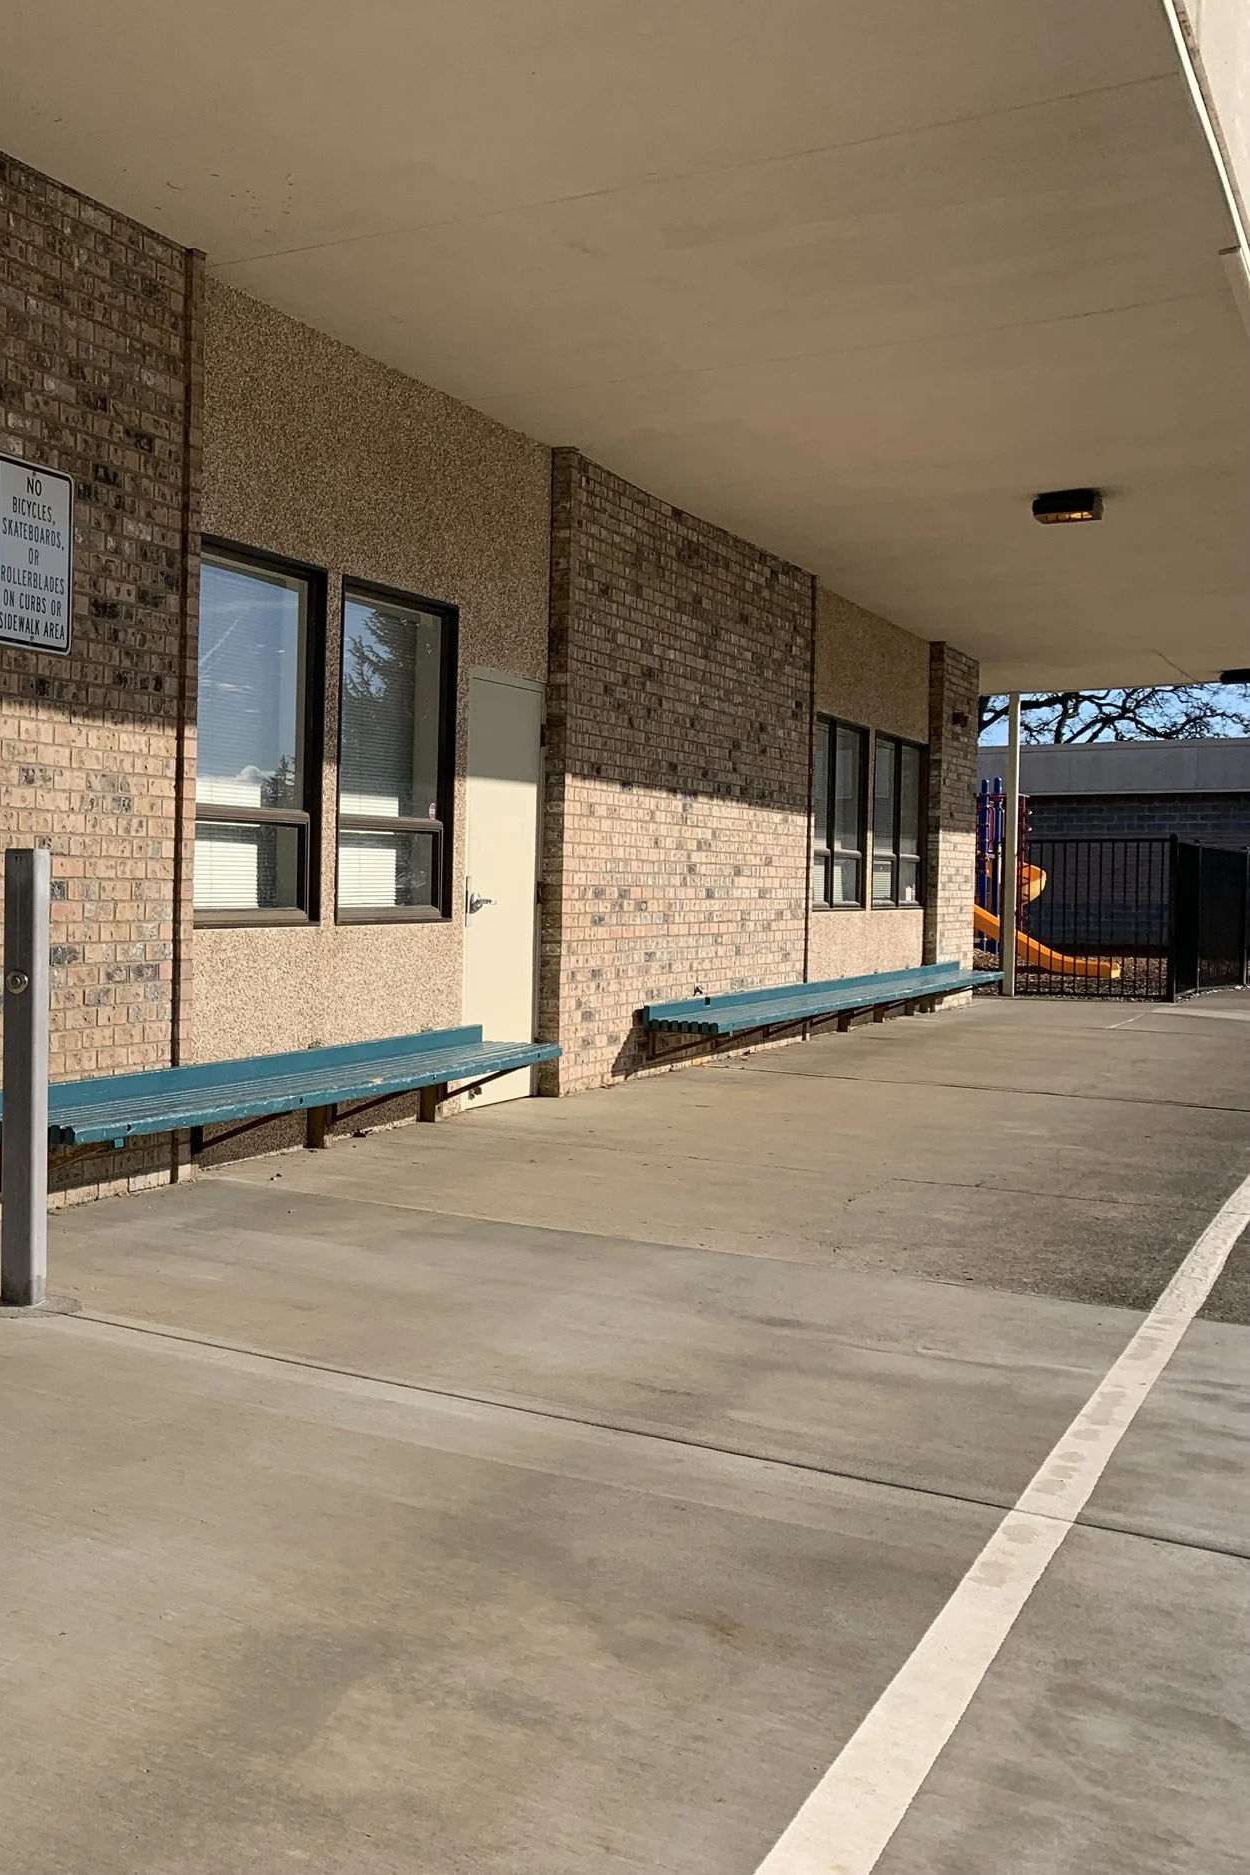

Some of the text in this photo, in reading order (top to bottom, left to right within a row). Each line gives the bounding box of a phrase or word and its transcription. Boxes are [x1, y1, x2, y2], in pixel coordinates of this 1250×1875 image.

[26, 477, 42, 497] NO
[12, 496, 56, 526] BICYCLES,
[2, 517, 65, 551] SKATEBOARDS,
[28, 547, 40, 566] OR
[0, 564, 65, 595] ROLLERBLADES
[3, 589, 62, 617] ON CURBS OR
[43, 621, 65, 640] AREA
